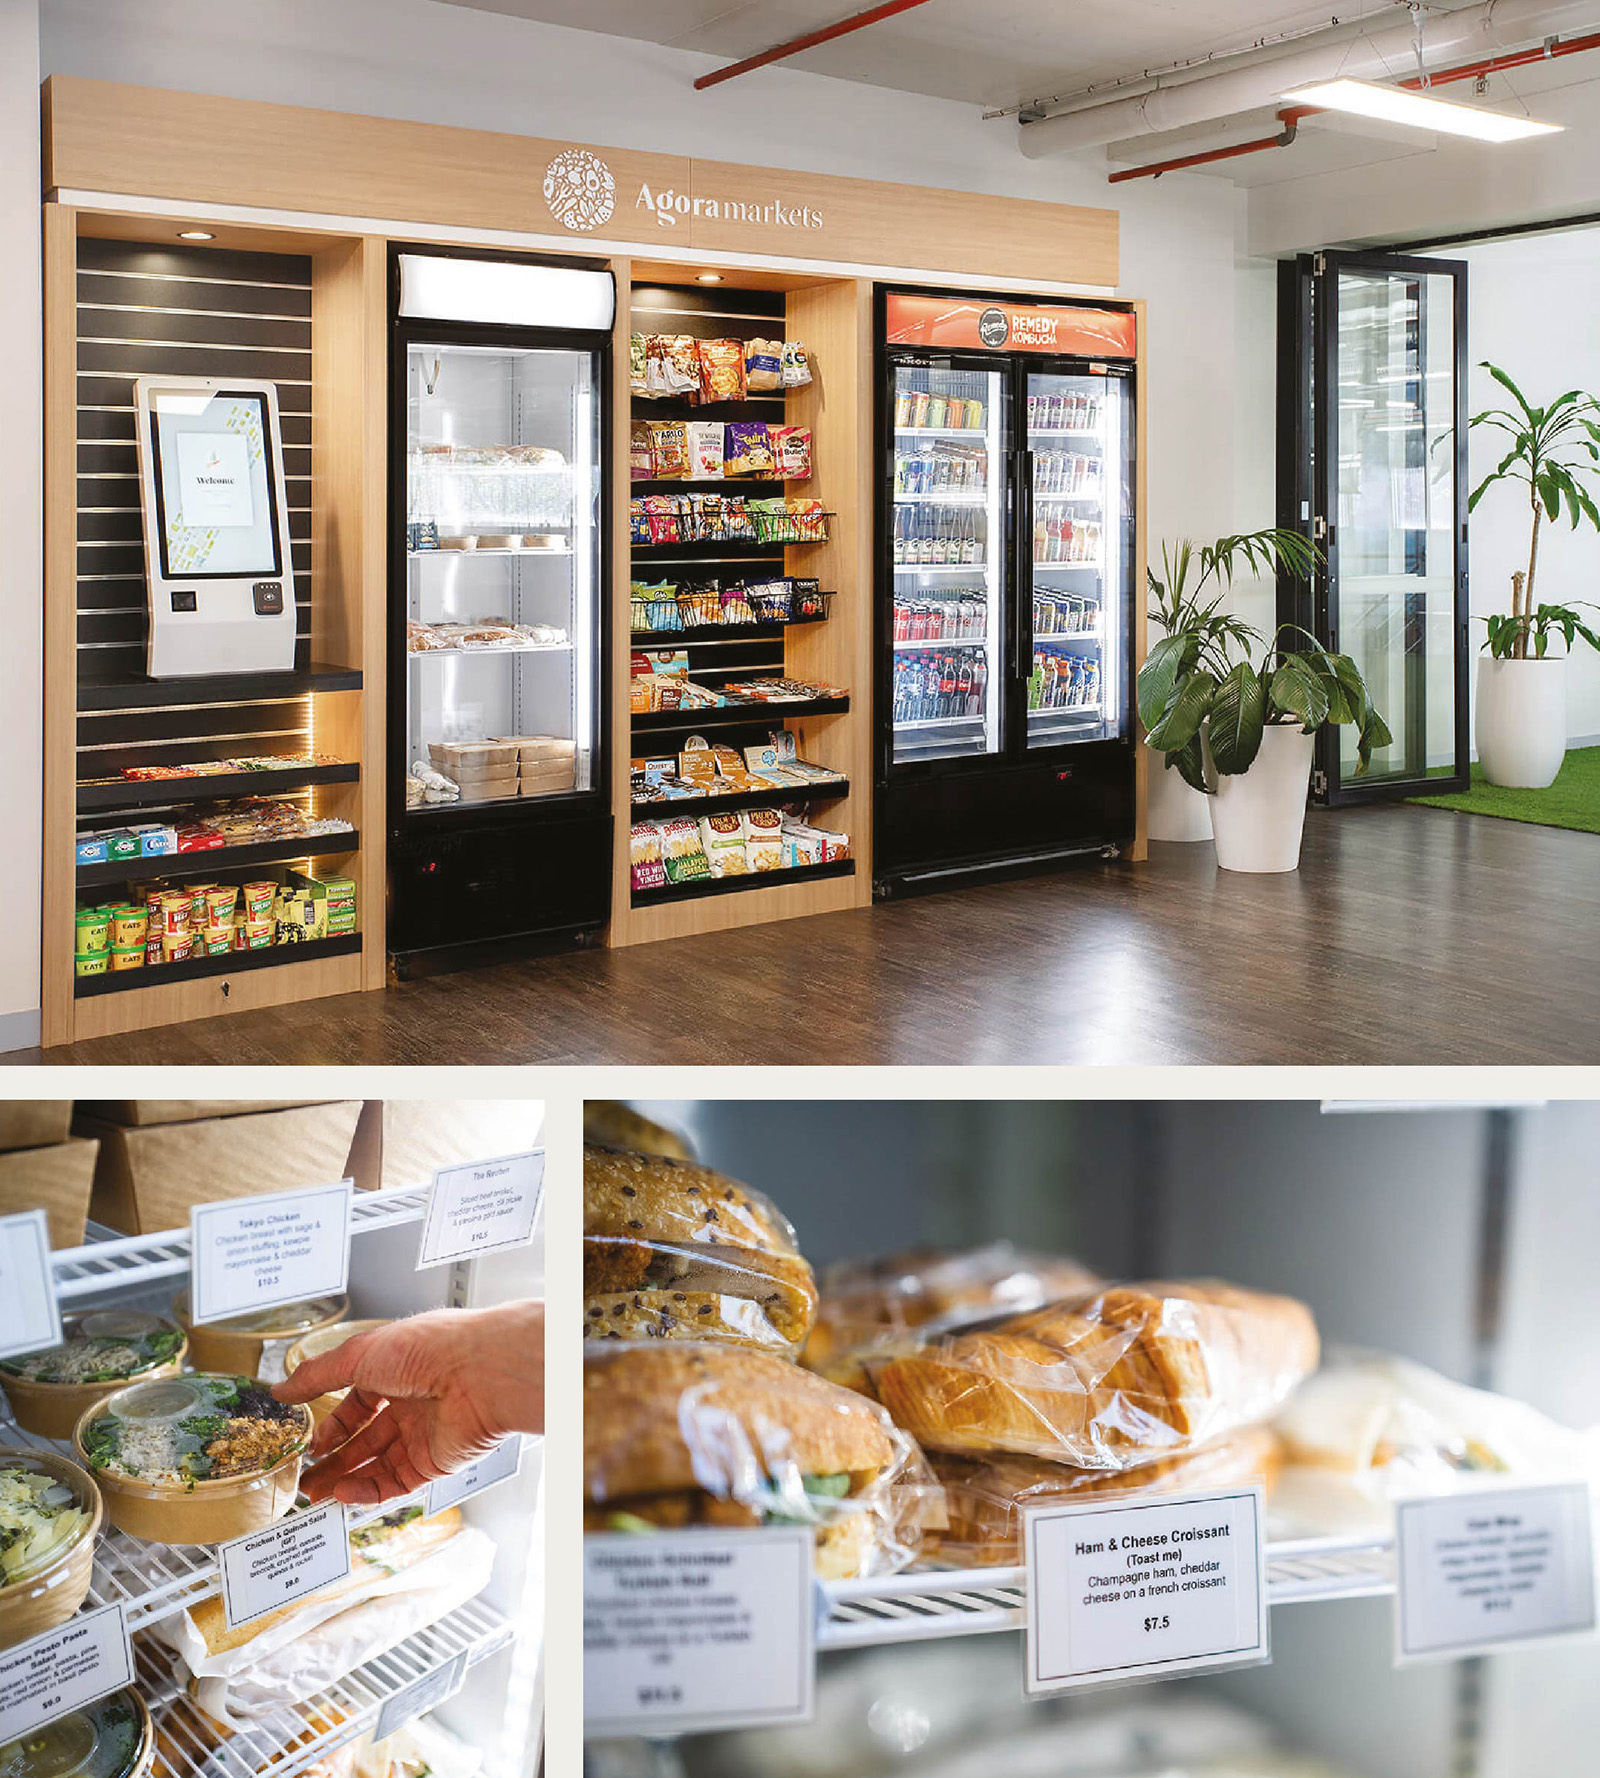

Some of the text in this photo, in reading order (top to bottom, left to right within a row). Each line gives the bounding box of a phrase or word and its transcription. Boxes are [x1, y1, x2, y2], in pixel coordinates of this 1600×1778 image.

[635, 183, 824, 229] Agora markets
[1012, 315, 1058, 333] REMEDY
[1011, 331, 1058, 345] KOMBUCHA
[196, 476, 235, 485] Welcome
[84, 963, 103, 971] EATS
[267, 1212, 300, 1225] Chicken
[215, 1233, 248, 1246] Chicken
[277, 1226, 293, 1235] with
[294, 1223, 313, 1233] sage
[315, 1221, 321, 1229] &
[283, 1235, 310, 1247] kewpie
[471, 1231, 488, 1242] $10.5
[224, 1246, 312, 1269] mayonnaise & cheddar
[254, 1265, 282, 1276] cheese
[258, 1276, 280, 1287] $10.5
[245, 1512, 327, 1552] Chicken & Quinoa Salad
[1075, 1523, 1230, 1556] Ham & Cheese Croissant
[280, 1535, 296, 1548] (GF)
[251, 1553, 278, 1569] Chicken
[276, 1552, 301, 1567] crushed
[1126, 1548, 1183, 1569] (Toast me)
[267, 1566, 289, 1580] quinoa
[1087, 1560, 1221, 1589] Champagne ham, cheddar
[1082, 1575, 1227, 1606] cheese on a french croissant
[1143, 1615, 1170, 1632] $7.5
[33, 1641, 61, 1657] Pesto
[62, 1628, 88, 1645] Pasta
[30, 1653, 57, 1670] Salad
[55, 1654, 79, 1668] pasta,
[80, 1643, 98, 1657] pine
[13, 1653, 100, 1696] red onion & parmesan
[6, 1685, 48, 1709] marinated
[49, 1681, 57, 1689] in
[58, 1671, 77, 1684] basil
[78, 1660, 100, 1677] pesto
[42, 1696, 62, 1710] $9.0
